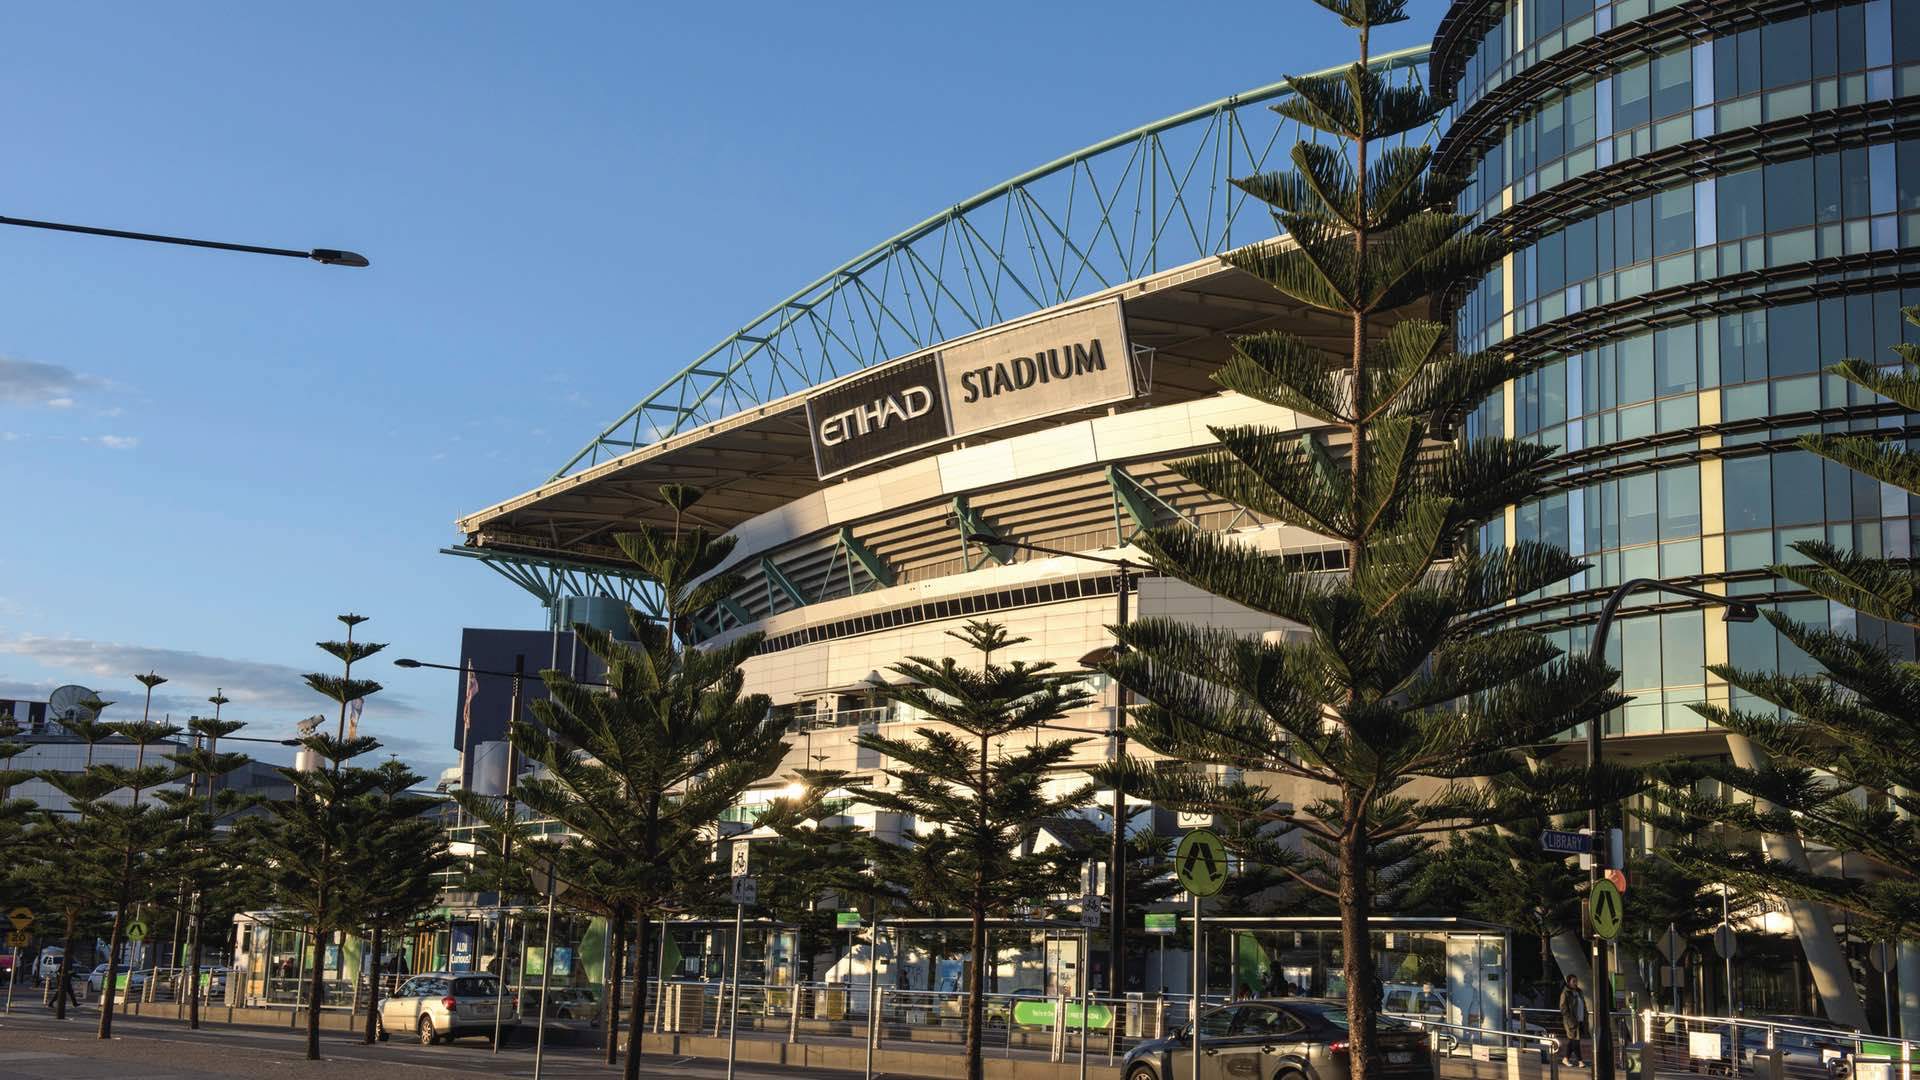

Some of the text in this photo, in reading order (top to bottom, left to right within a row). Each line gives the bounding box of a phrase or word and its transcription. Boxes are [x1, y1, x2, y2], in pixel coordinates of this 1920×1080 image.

[819, 338, 1107, 446] ETIHAD STADIUM
[1548, 834, 1582, 850] LIBRARY
